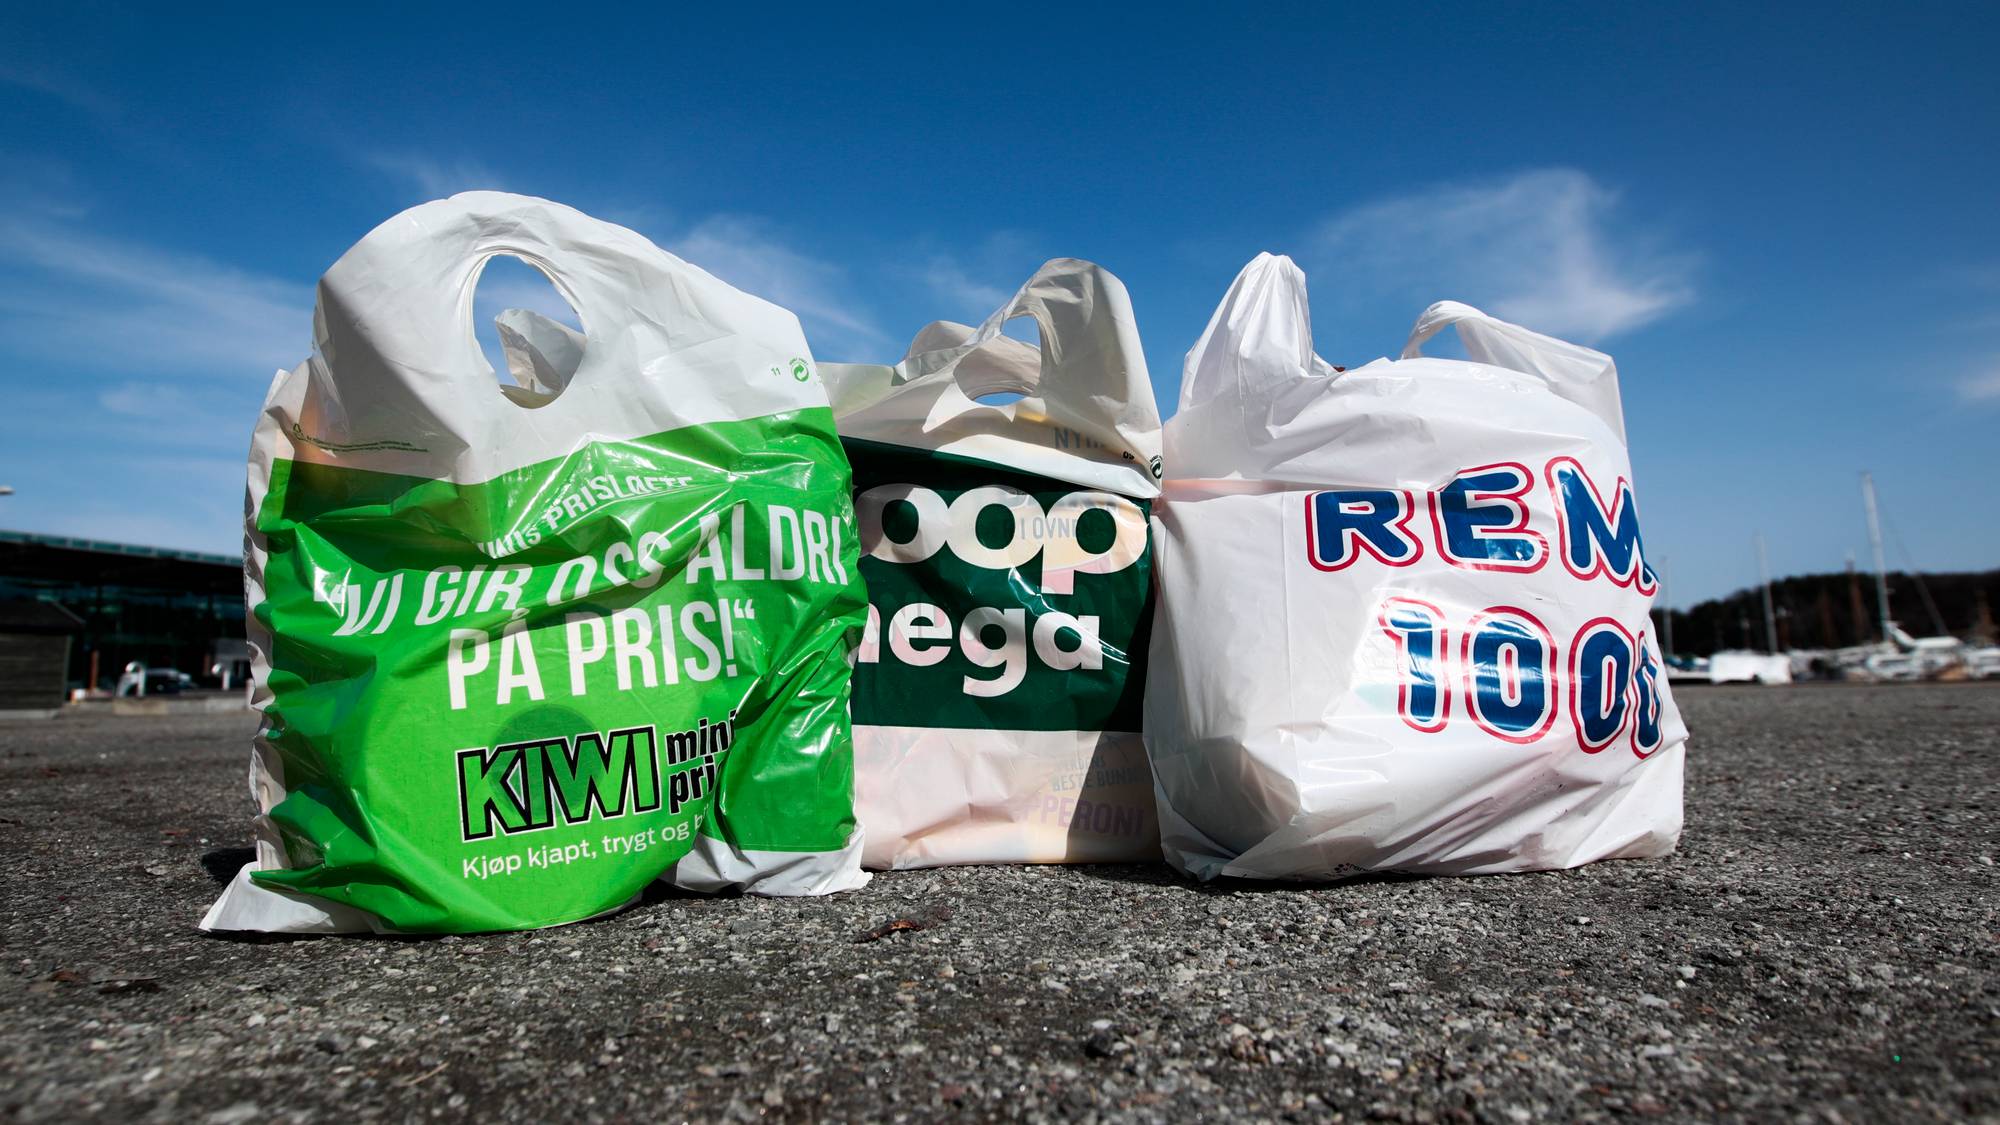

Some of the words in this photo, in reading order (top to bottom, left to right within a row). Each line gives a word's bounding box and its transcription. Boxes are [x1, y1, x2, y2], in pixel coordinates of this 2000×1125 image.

[414, 563, 534, 627] GIR
[686, 503, 849, 586] ALDRI
[852, 482, 1149, 596] oop
[1304, 456, 1661, 597] REM
[447, 608, 546, 711] PÅ
[1377, 597, 1664, 760] 1000
[456, 724, 662, 843] KIWI
[668, 753, 717, 816] pri
[463, 854, 522, 880] Kjøp
[528, 838, 598, 869] kjapt,
[602, 827, 657, 855] trygt
[661, 822, 691, 842] og
